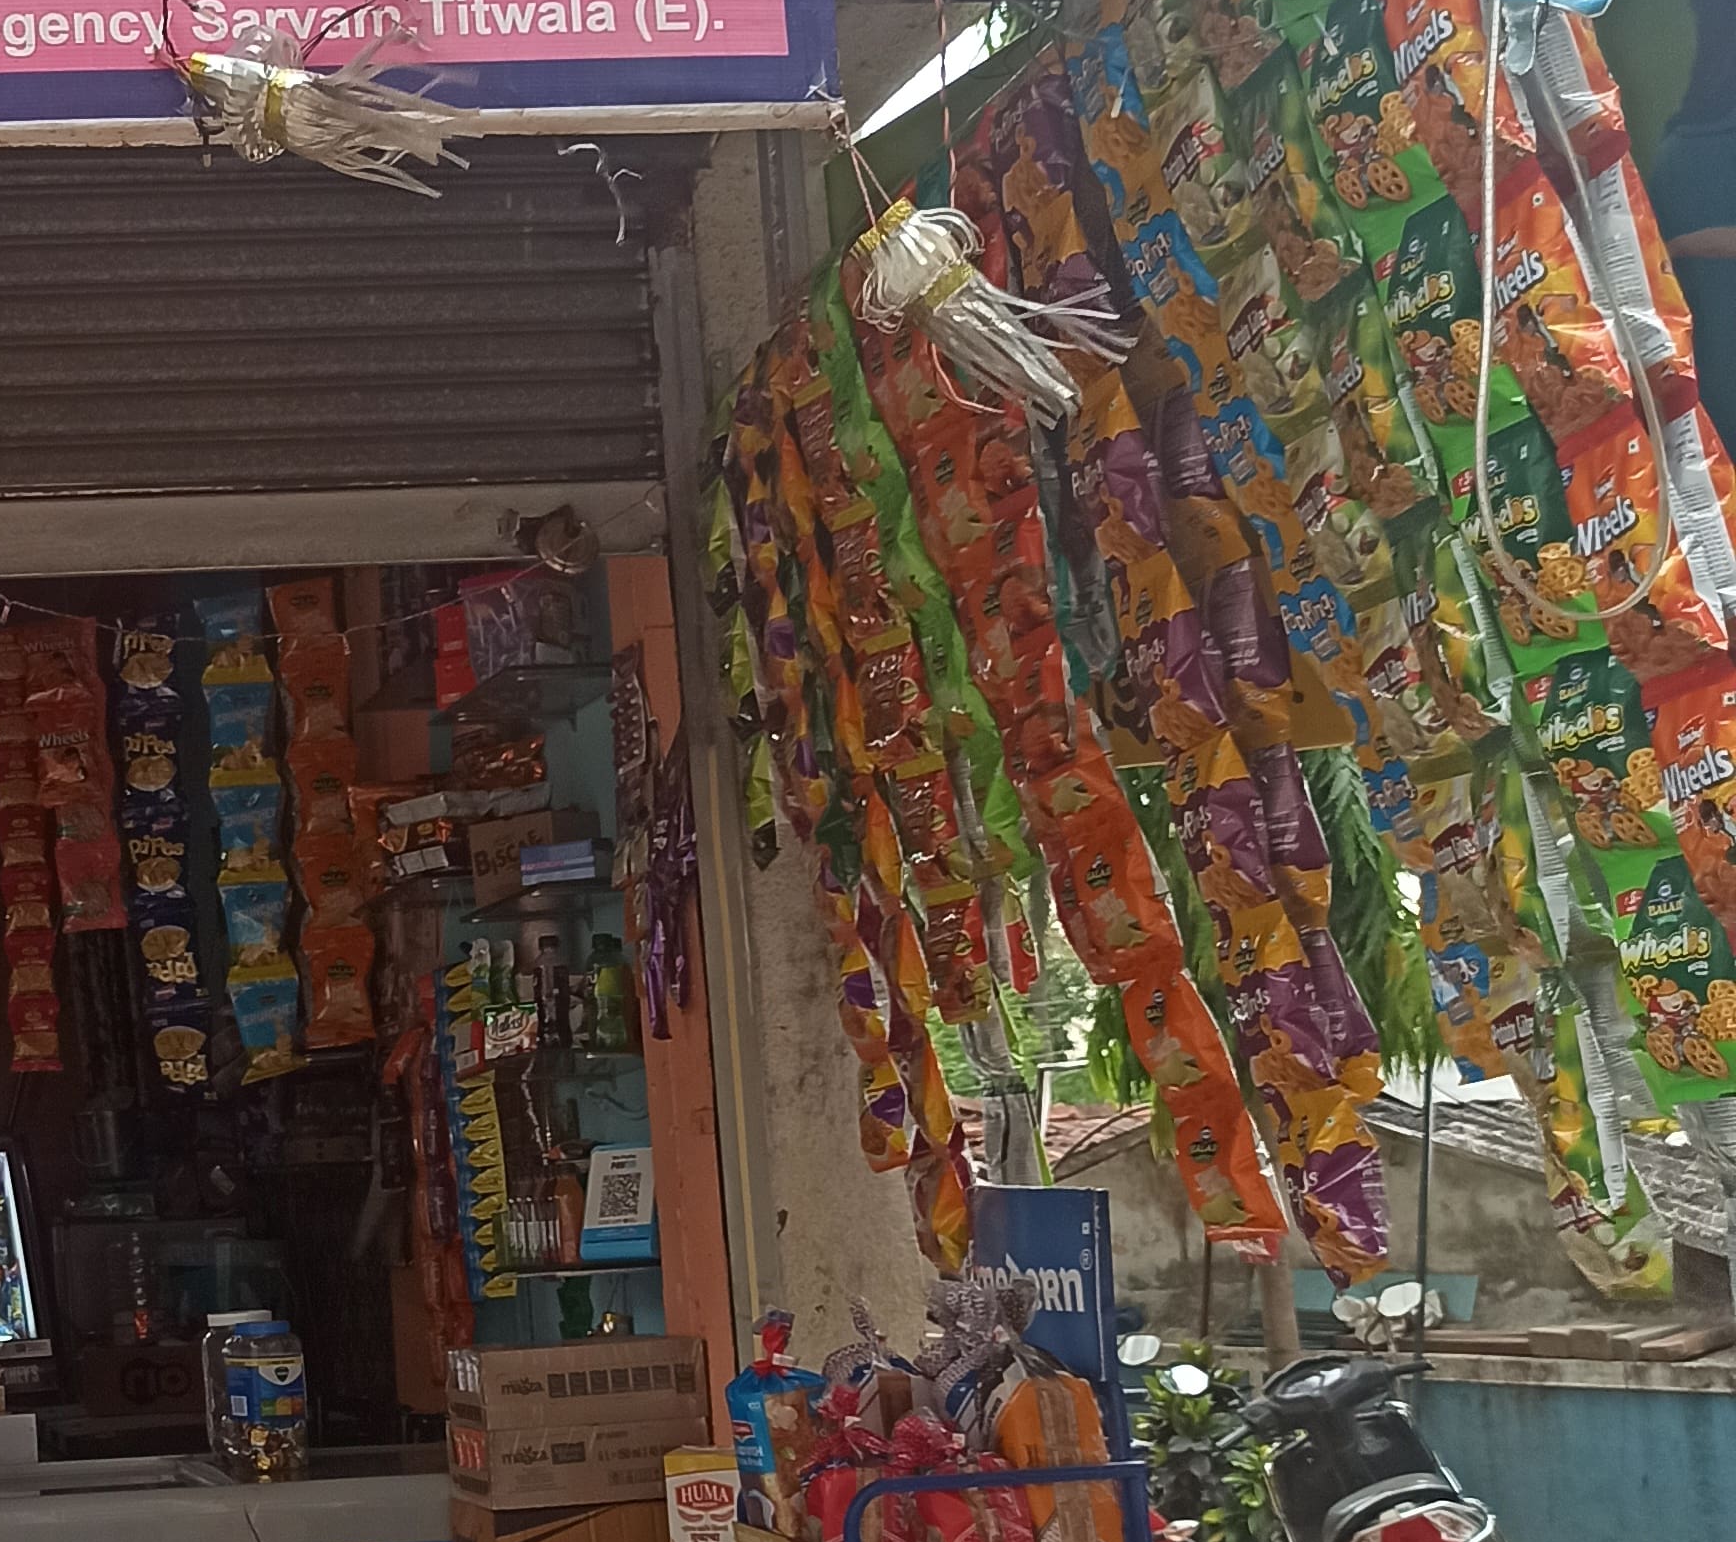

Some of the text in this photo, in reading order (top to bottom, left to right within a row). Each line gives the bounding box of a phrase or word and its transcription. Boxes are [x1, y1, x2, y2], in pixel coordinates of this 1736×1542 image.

[1662, 745, 1735, 803] Wheels
[1618, 924, 1711, 971] Wheelos
[680, 1484, 730, 1505] HUMA
